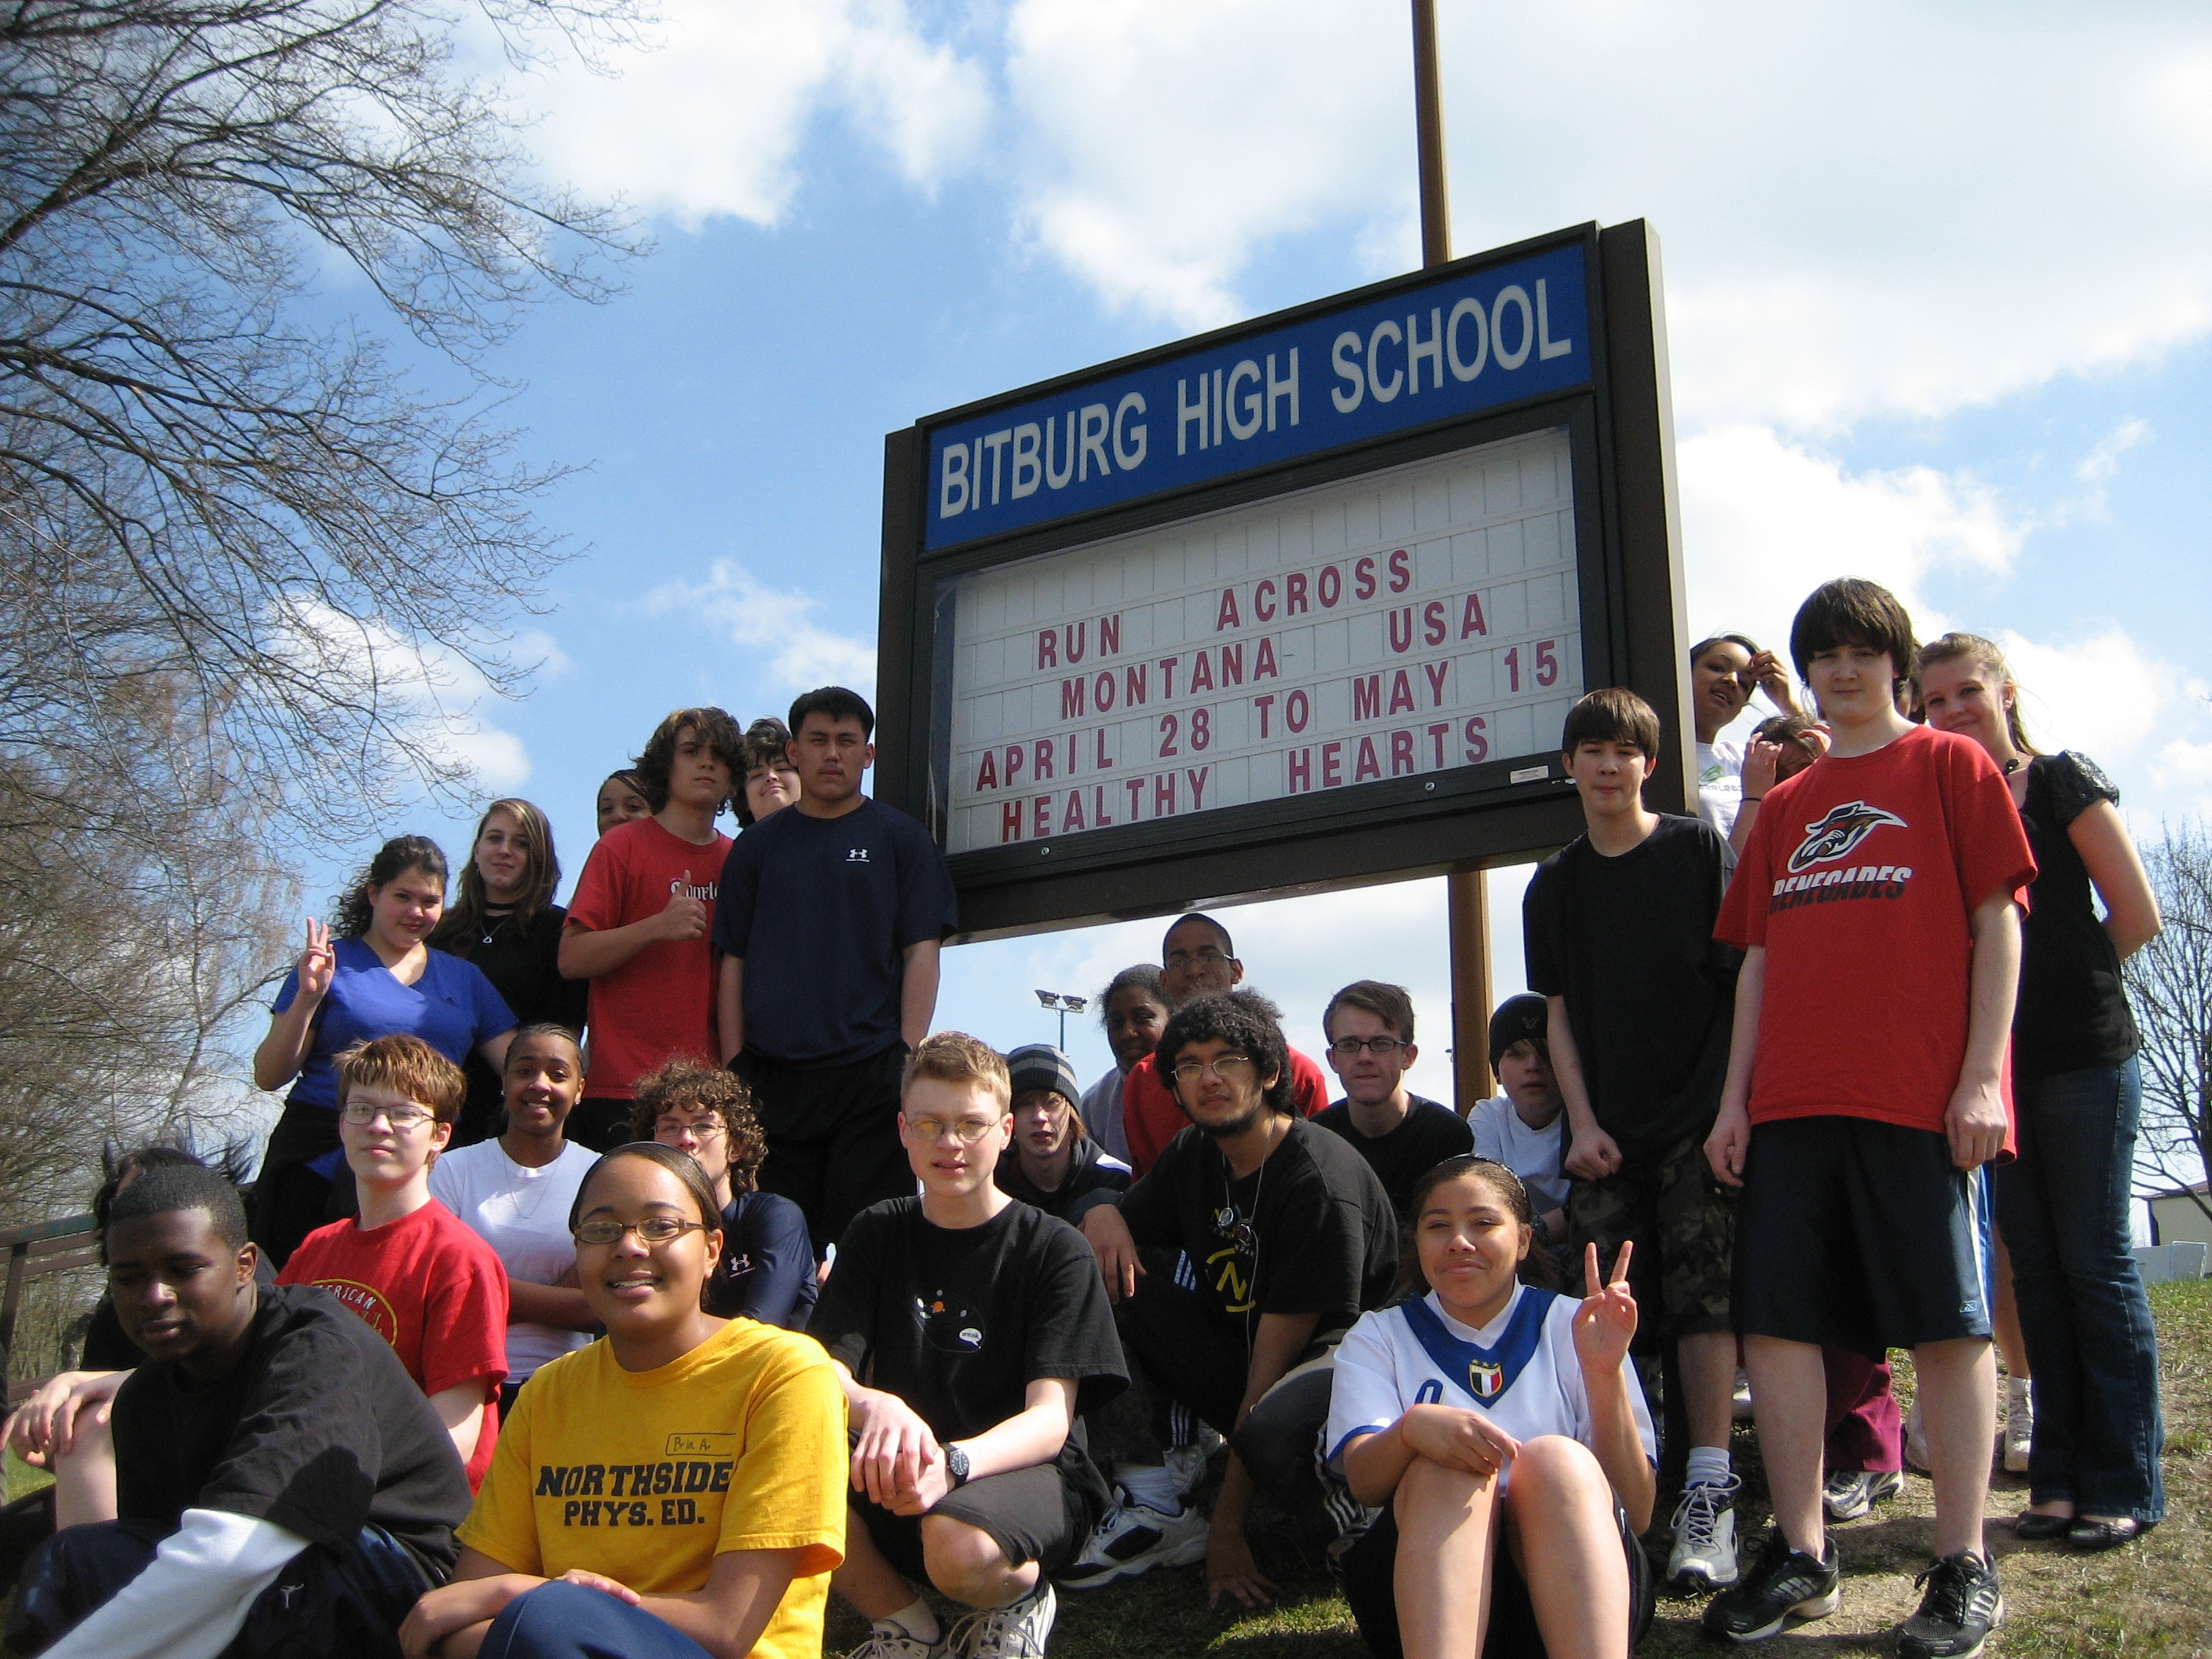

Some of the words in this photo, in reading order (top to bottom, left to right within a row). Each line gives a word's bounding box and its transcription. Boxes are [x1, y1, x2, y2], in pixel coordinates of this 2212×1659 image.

[939, 391, 1147, 518] BITBURG
[1177, 346, 1300, 456] HIGH
[1331, 278, 1572, 414] SCHOOL
[1038, 613, 1119, 670] RUN
[1217, 549, 1411, 631] ACROSS
[1061, 637, 1278, 720] MONTANA
[1389, 593, 1488, 654] USA
[976, 728, 1113, 792] APRIL
[1159, 708, 1210, 758] 28
[1254, 690, 1309, 738] TO
[1353, 661, 1448, 721] MAY
[1503, 640, 1558, 692] 15
[1002, 766, 1209, 843] HEALTHY
[1288, 716, 1489, 794] HEARTS
[1769, 866, 1913, 914] RENEGADES
[535, 1461, 734, 1497] NORTHSIDE
